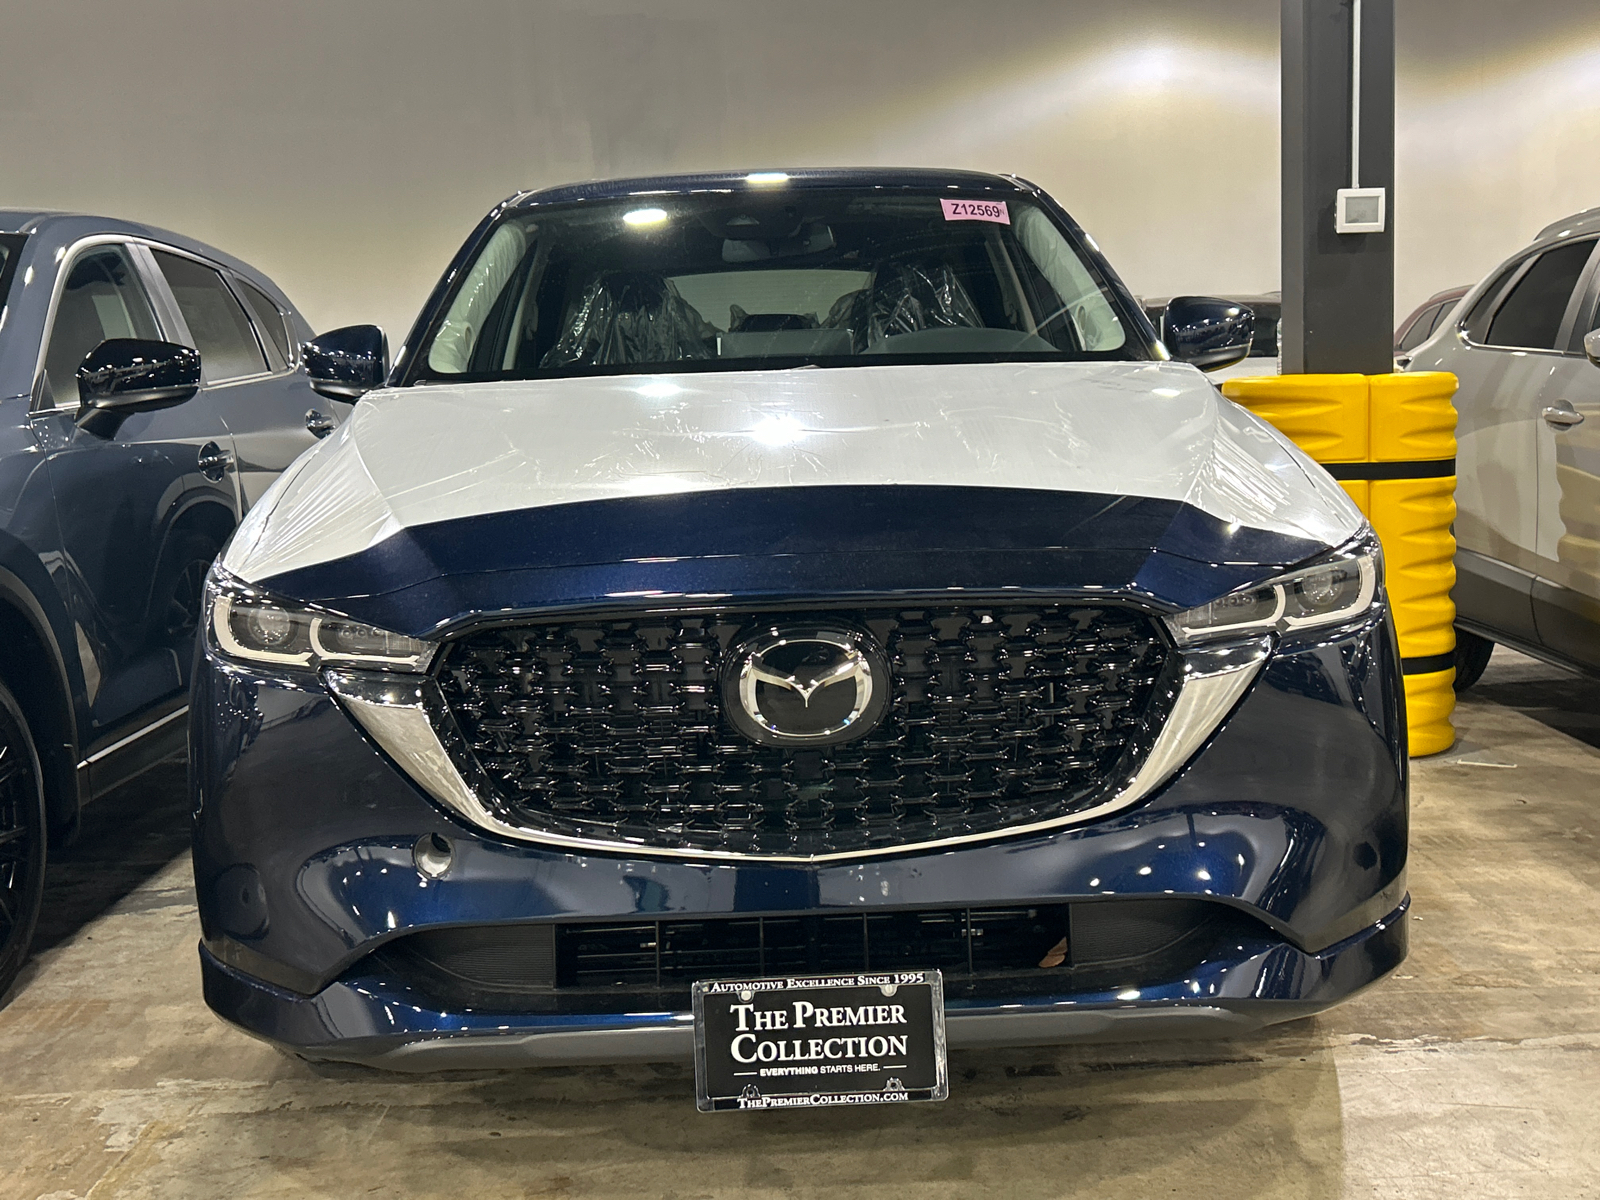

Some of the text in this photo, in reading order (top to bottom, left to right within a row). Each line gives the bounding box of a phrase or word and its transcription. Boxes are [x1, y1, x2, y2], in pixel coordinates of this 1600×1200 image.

[951, 203, 1000, 217] Z12569
[711, 973, 924, 992] AUTOMOTIVE EXCELLENCE SINCE 1995
[730, 1001, 907, 1032] THE PREMIER
[730, 1033, 908, 1063] COLLECTION
[759, 1063, 881, 1077] EVERYTHING STARTS HERE.
